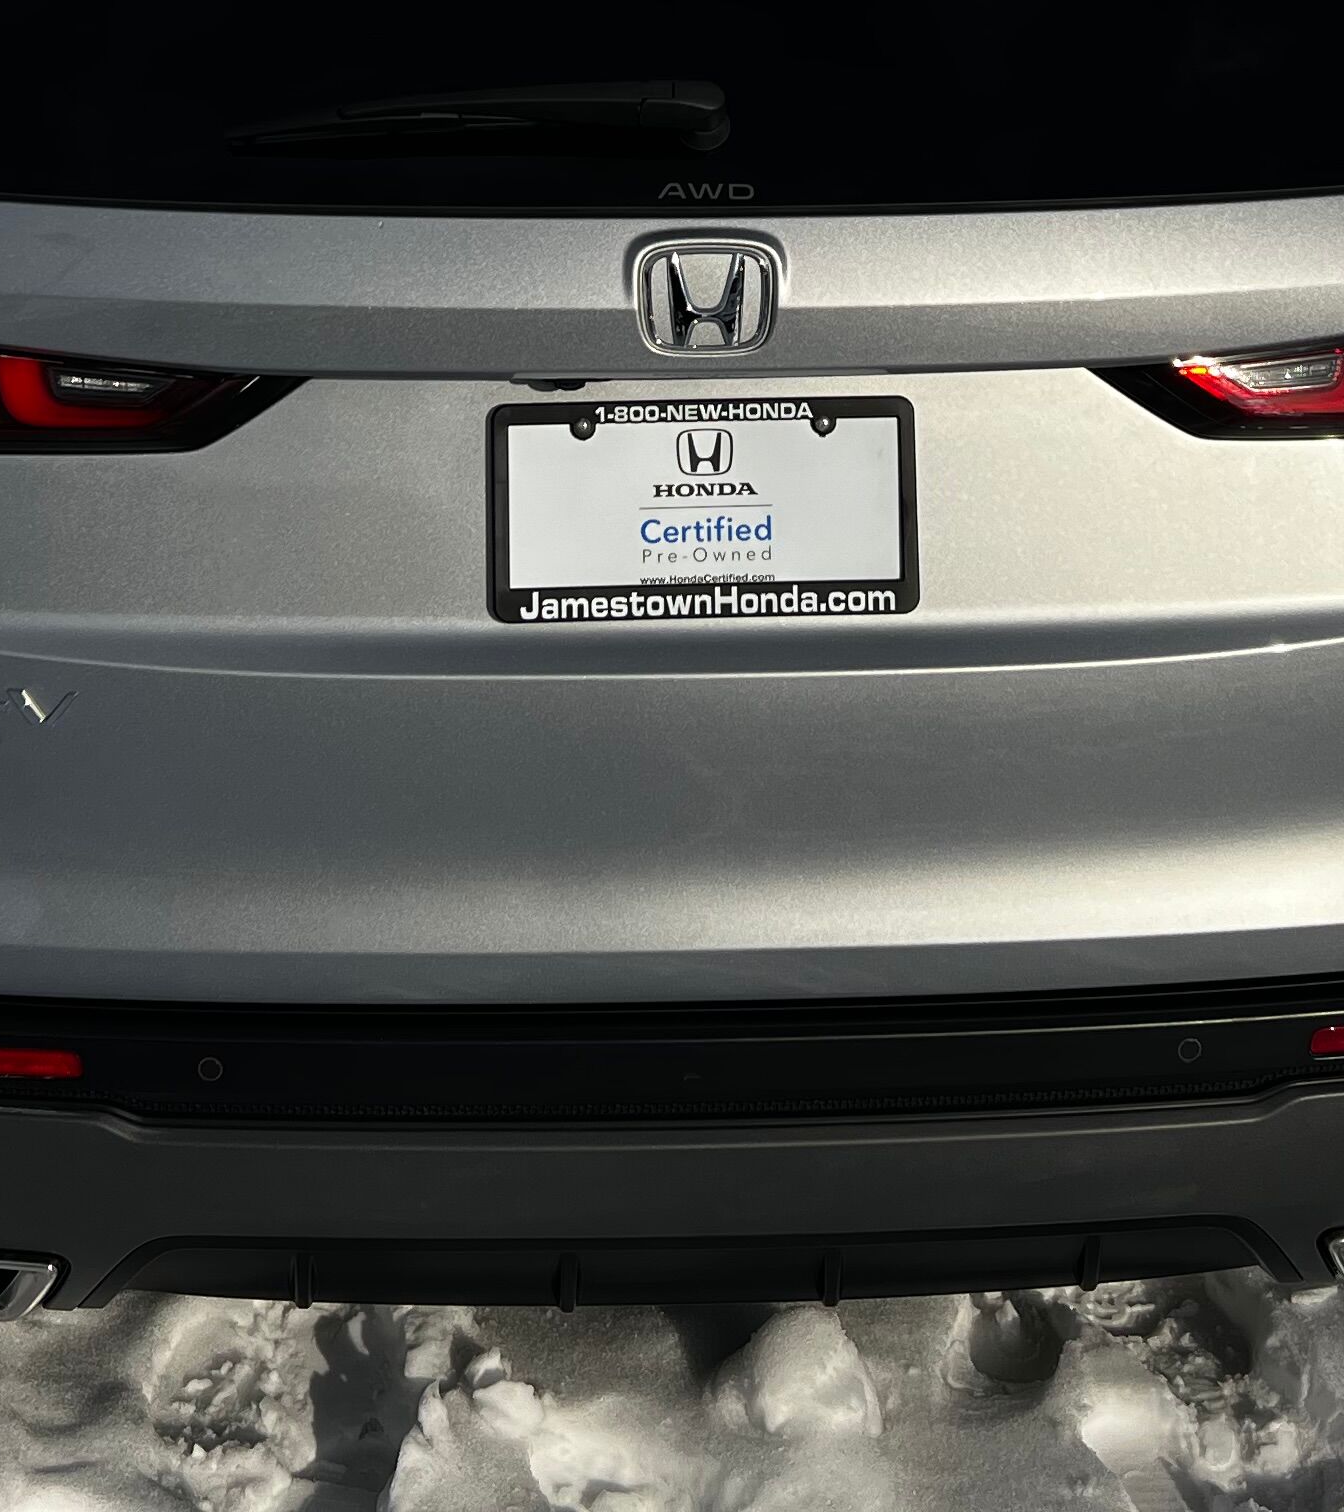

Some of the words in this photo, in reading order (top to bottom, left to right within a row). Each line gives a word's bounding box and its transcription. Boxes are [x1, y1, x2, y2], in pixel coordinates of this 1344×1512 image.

[657, 182, 755, 200] AWD
[594, 402, 814, 424] 1-800-NEW-HONDA
[652, 482, 759, 498] HONDA
[640, 514, 772, 544] Certified
[642, 545, 772, 564] Pre-Owned
[640, 573, 775, 585] www.HondaCertified.com
[520, 584, 896, 621] JamestownHonda.com
